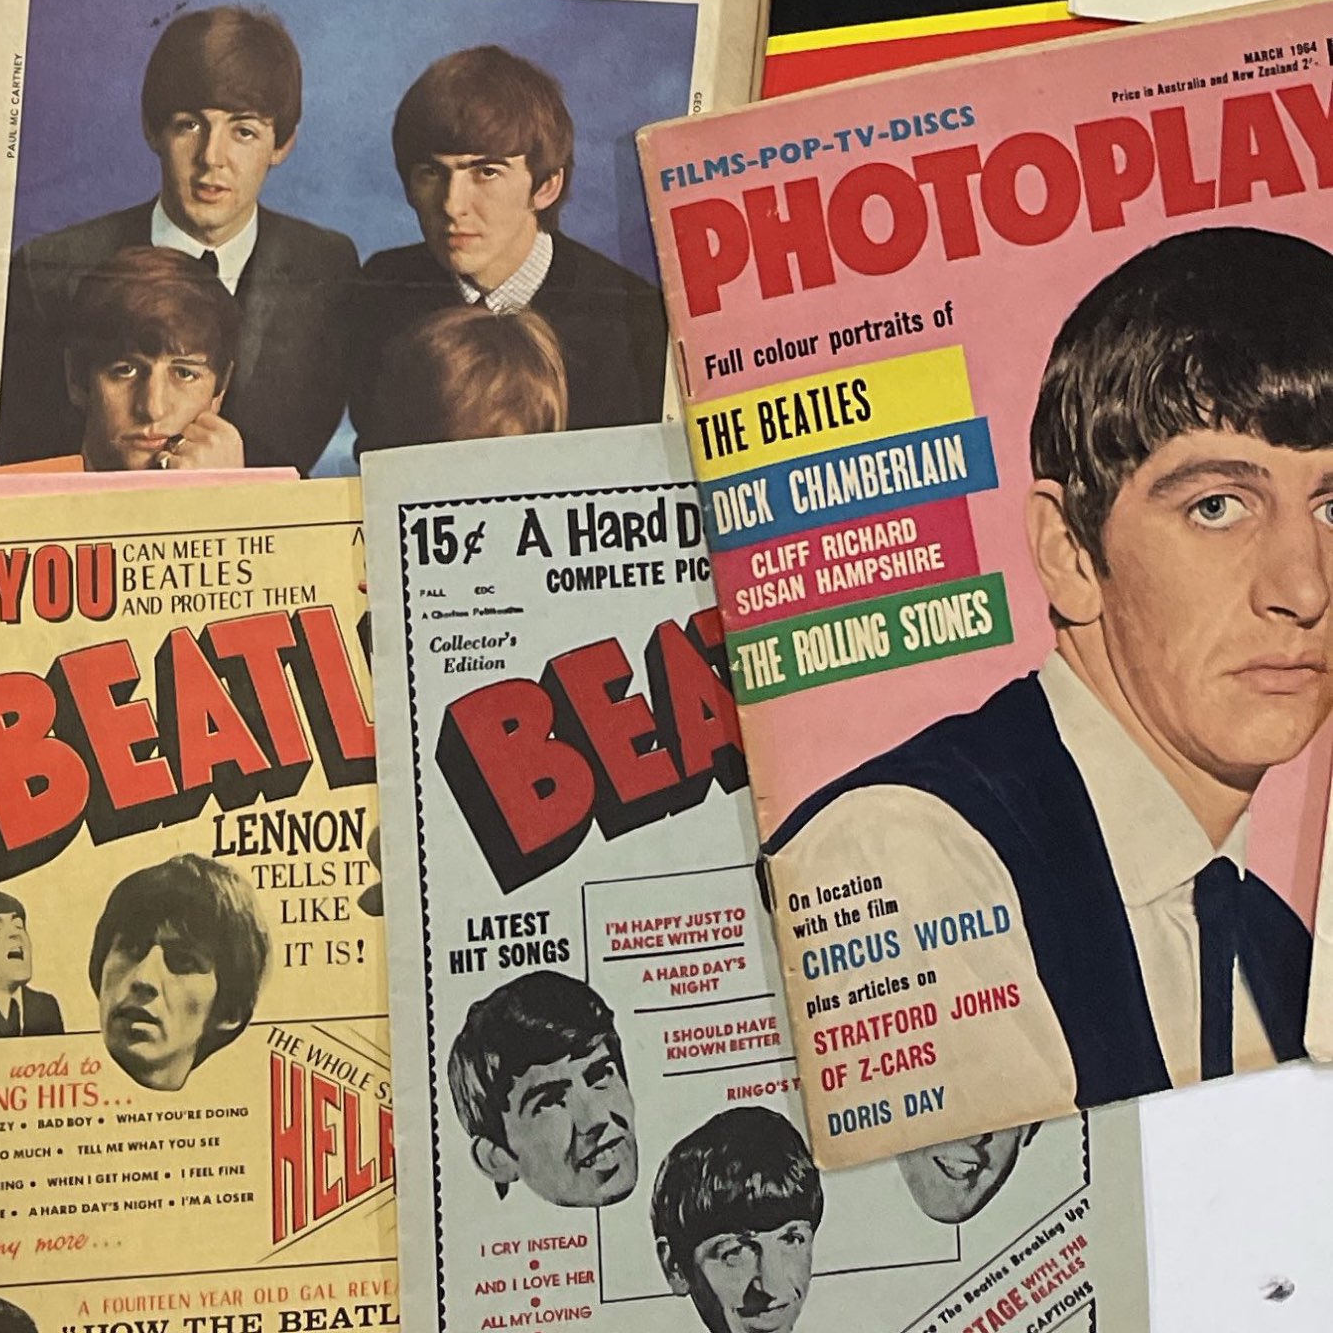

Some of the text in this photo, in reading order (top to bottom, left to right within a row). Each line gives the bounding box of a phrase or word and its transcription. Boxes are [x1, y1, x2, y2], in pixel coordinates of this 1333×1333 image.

[1244, 42, 1318, 65] MARCH 1964
[704, 301, 955, 380] Full colour portraits of
[697, 378, 872, 461] THE BEATLES
[712, 434, 967, 535] DICK CHAMBERLAIN
[122, 535, 276, 563] CAN MEET THE
[409, 514, 486, 566] 15¢
[122, 559, 254, 592] BEATLES
[546, 561, 665, 594] COMPLETE
[122, 585, 317, 616] AND PROTECT THEM
[736, 589, 993, 691] THE ROLLING STONES
[466, 911, 551, 942] LATEST
[802, 904, 1011, 980] CIRCUS WORLD
[449, 939, 570, 975] HIT SONGS
[38, 1116, 92, 1129] BAD BOY
[116, 1107, 249, 1125] WHAT YOU'RE DOING
[102, 1285, 337, 1316] FOURTEEN YEAR OLD GAL
